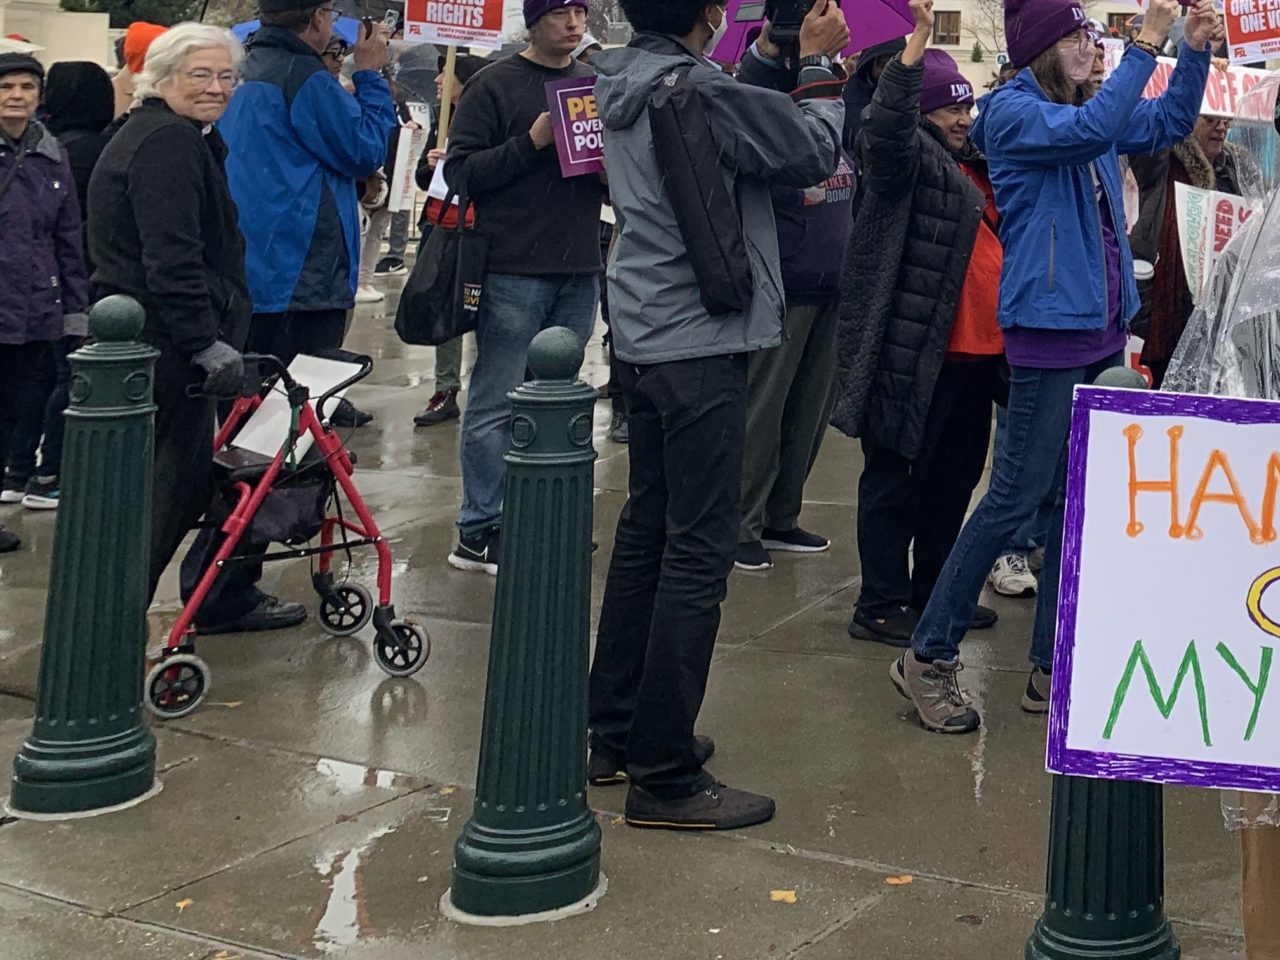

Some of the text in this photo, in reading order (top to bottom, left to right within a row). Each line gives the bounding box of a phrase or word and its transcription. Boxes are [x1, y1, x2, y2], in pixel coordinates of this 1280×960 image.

[426, 1, 484, 28] RIGHTS
[1240, 12, 1267, 34] ONE
[1234, 47, 1247, 58] PSL
[1260, 40, 1277, 48] PARTY
[1206, 71, 1238, 113] OFF
[567, 95, 599, 121] PE
[574, 132, 604, 151] POL
[825, 175, 846, 189] LIKE
[826, 187, 851, 203] BOMB
[1213, 199, 1234, 252] NEED
[1102, 639, 1274, 748] MY
